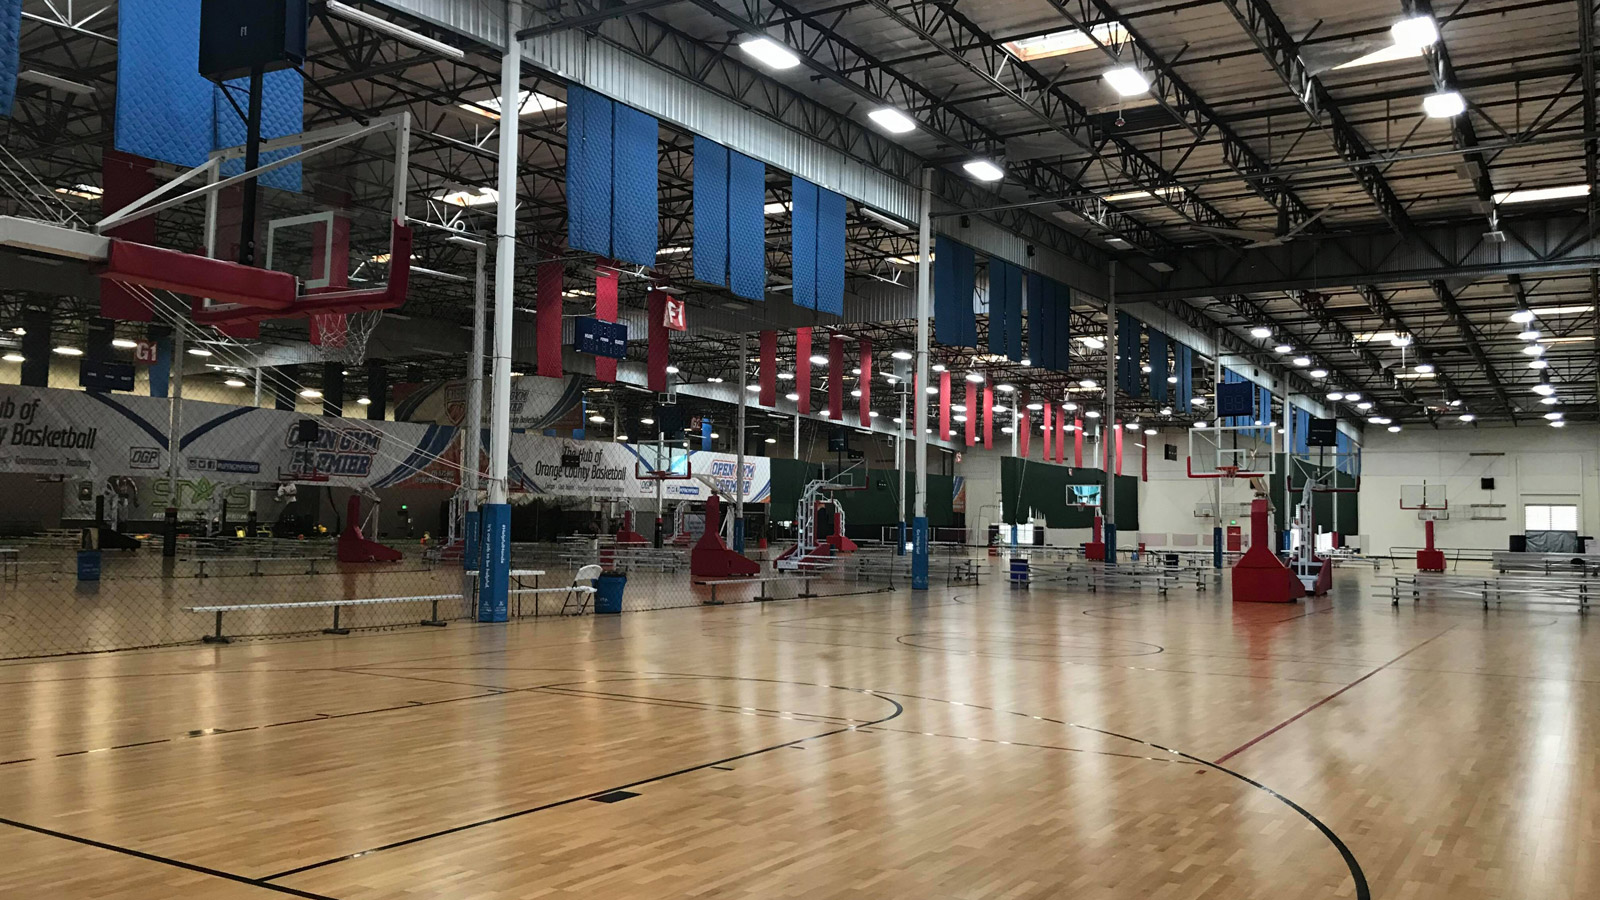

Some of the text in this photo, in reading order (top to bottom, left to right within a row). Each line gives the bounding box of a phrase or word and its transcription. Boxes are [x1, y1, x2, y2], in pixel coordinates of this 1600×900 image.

[667, 300, 684, 327] F1
[136, 342, 157, 361] G1
[20, 398, 41, 425] of
[11, 423, 97, 449] Basketball
[339, 429, 379, 452] GYM
[579, 447, 593, 463] Hub
[594, 448, 604, 466] of
[535, 460, 627, 482] Orange County Basketball
[711, 461, 736, 476] OPEN
